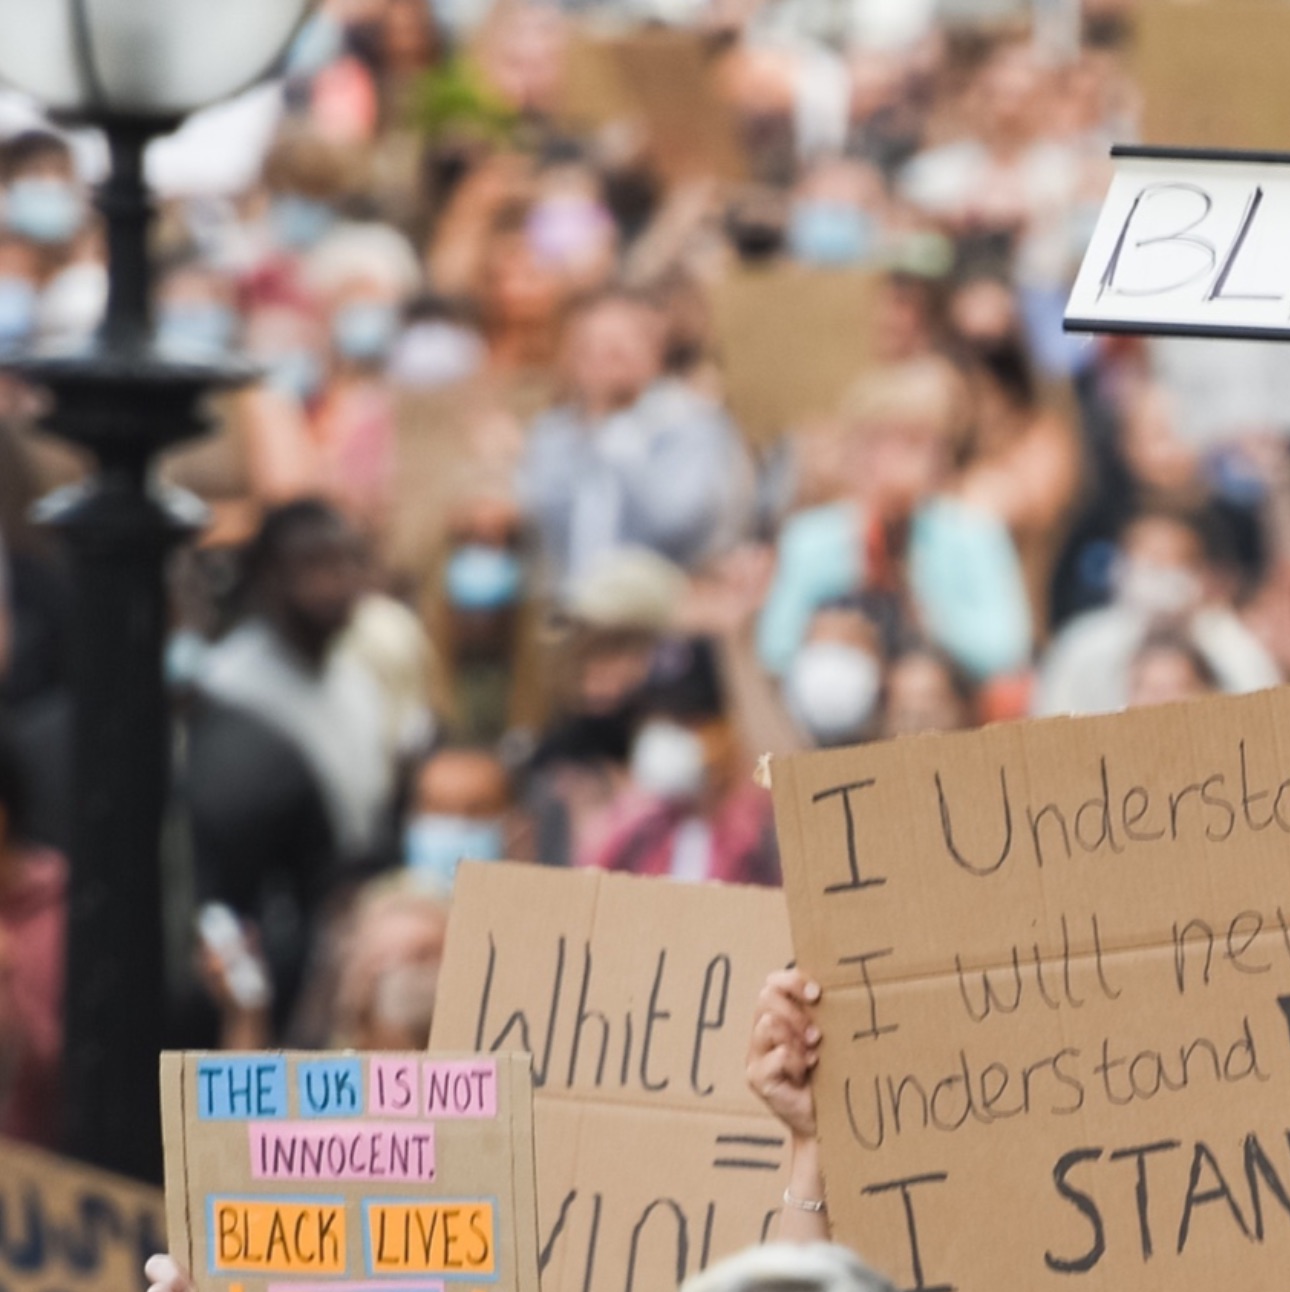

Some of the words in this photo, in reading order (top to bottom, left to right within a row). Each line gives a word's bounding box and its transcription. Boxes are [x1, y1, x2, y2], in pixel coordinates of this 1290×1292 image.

[812, 778, 887, 894] I
[839, 948, 898, 1041] I
[955, 914, 1121, 1022] will
[200, 1063, 278, 1116] THE
[305, 1066, 358, 1112] UK
[371, 1069, 412, 1107] IS
[426, 1068, 494, 1112] NOT
[259, 1131, 437, 1179] INNOCENT.
[218, 1206, 342, 1265] BLACK
[373, 1204, 490, 1268] LIVES
